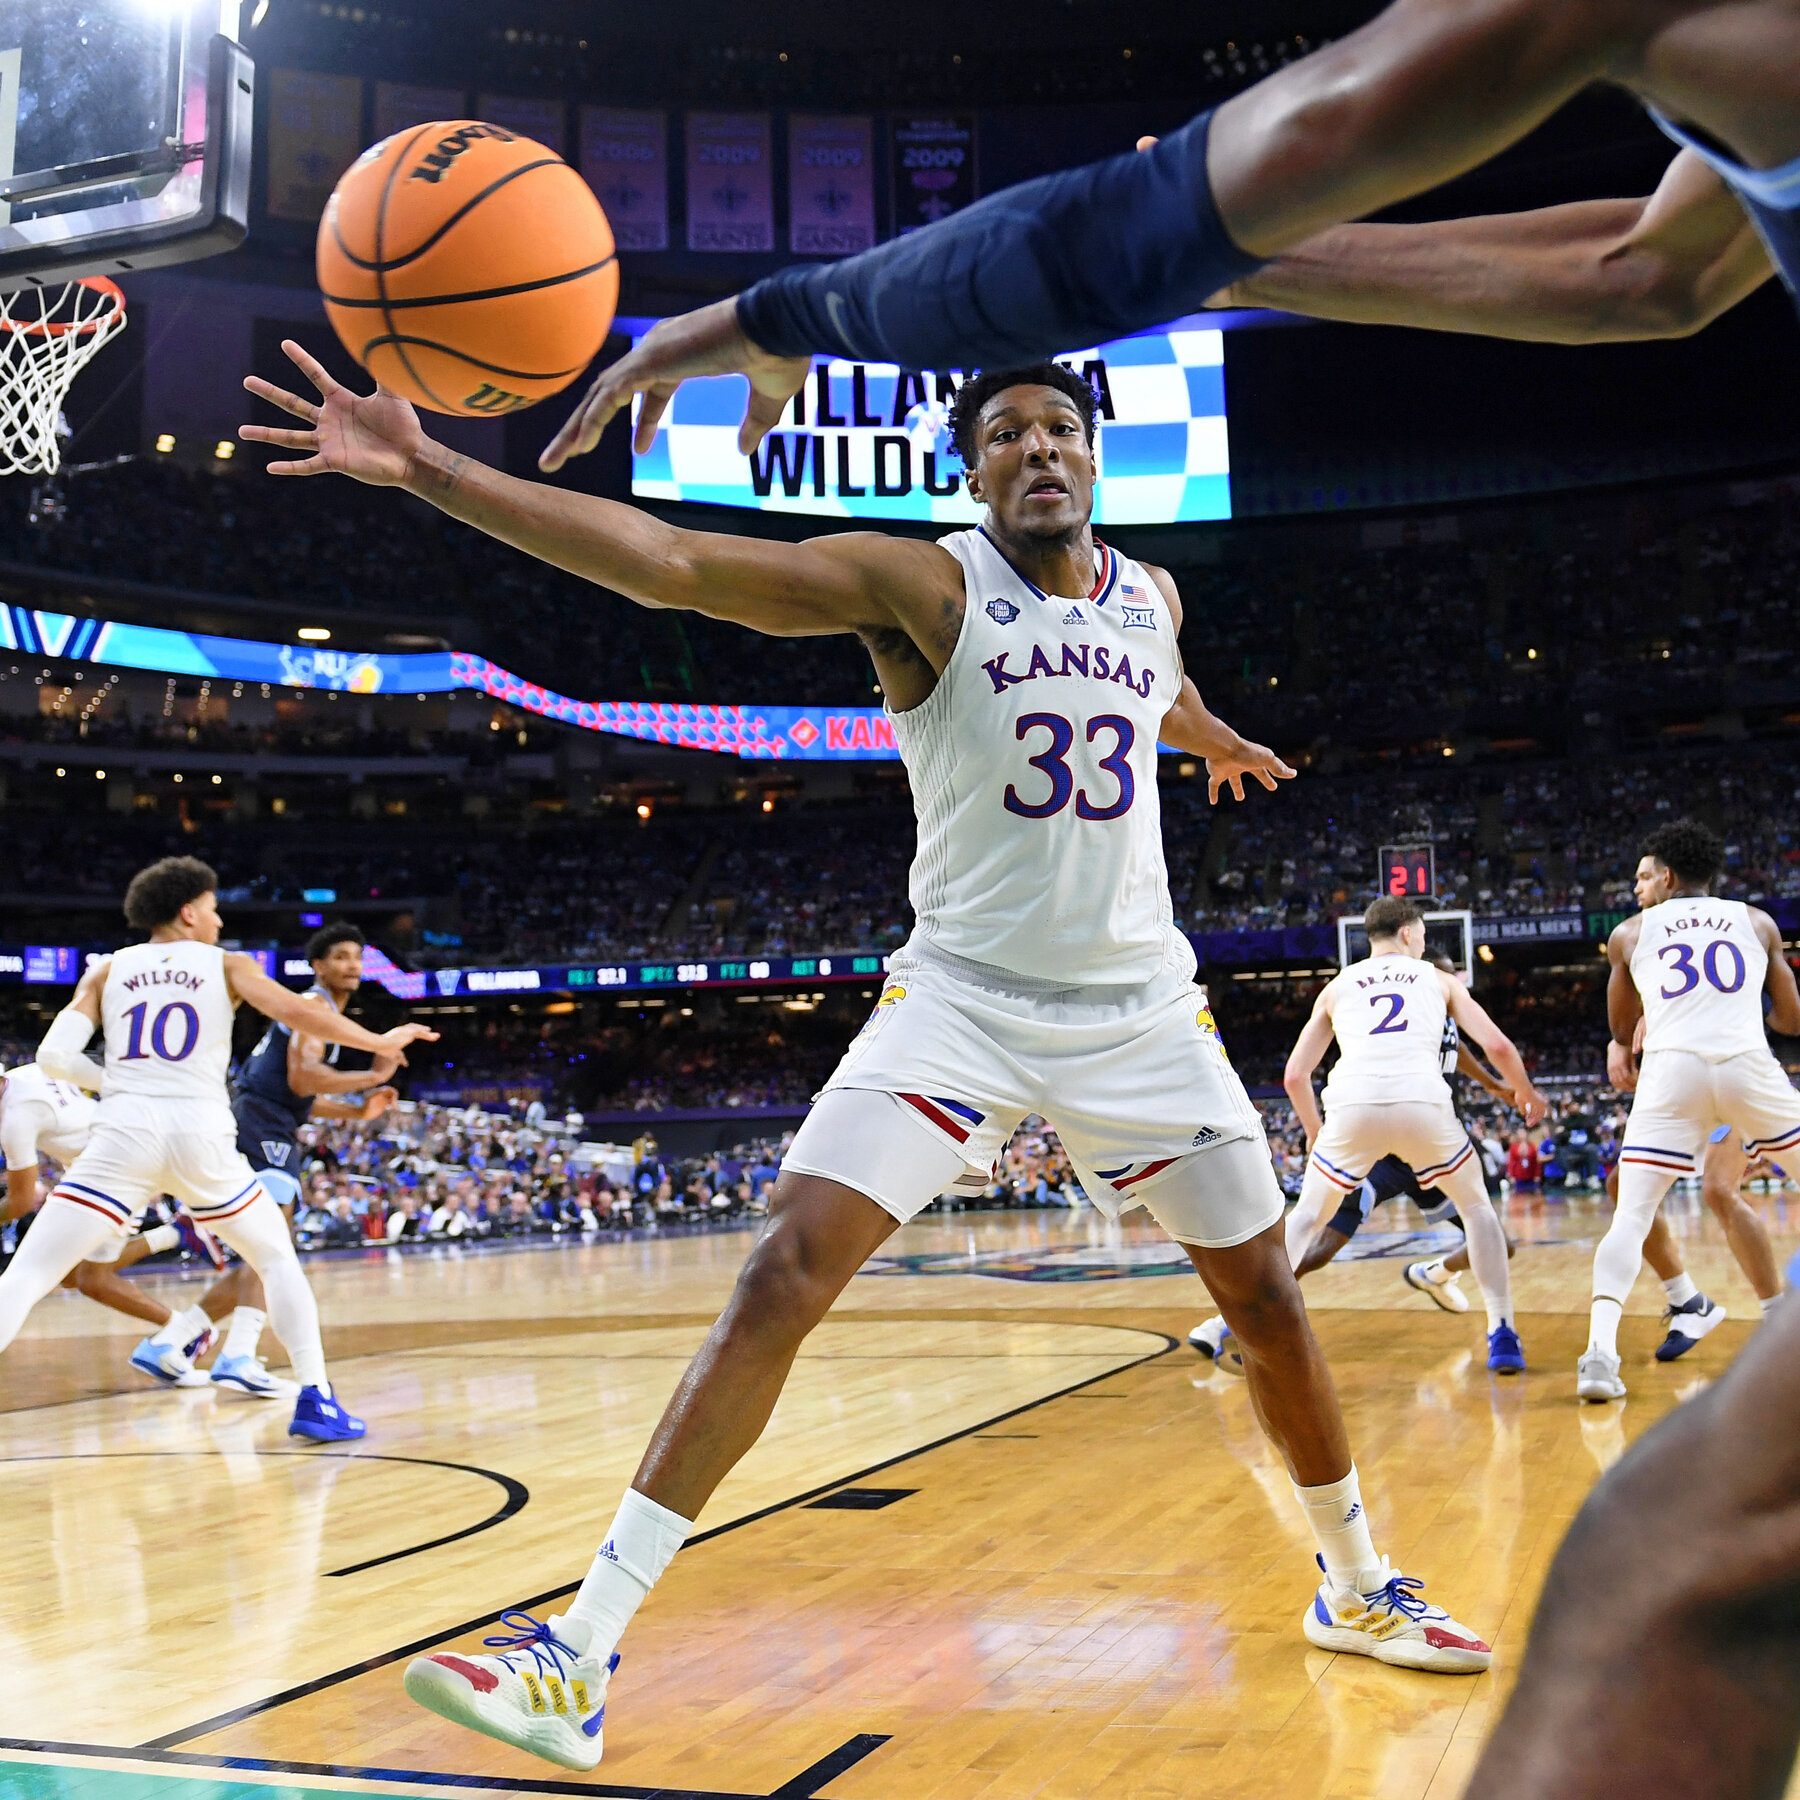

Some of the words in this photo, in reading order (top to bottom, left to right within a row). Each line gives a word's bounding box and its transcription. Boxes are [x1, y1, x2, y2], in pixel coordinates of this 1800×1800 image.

[903, 148, 966, 169] 2009
[751, 434, 961, 498] WILDC
[1062, 617, 1089, 626] adidas
[981, 642, 1155, 698] KANSAS
[825, 716, 898, 750] KAN
[1003, 712, 1135, 820] 33
[1389, 865, 1426, 896] 21
[1664, 917, 1733, 937] AGBAJI
[123, 969, 205, 993] WILSON
[1356, 973, 1419, 989] BRAUN
[1658, 939, 1746, 1000] 30
[1368, 993, 1408, 1035] 2
[118, 1001, 200, 1061] 10
[1192, 1132, 1222, 1147] adidas
